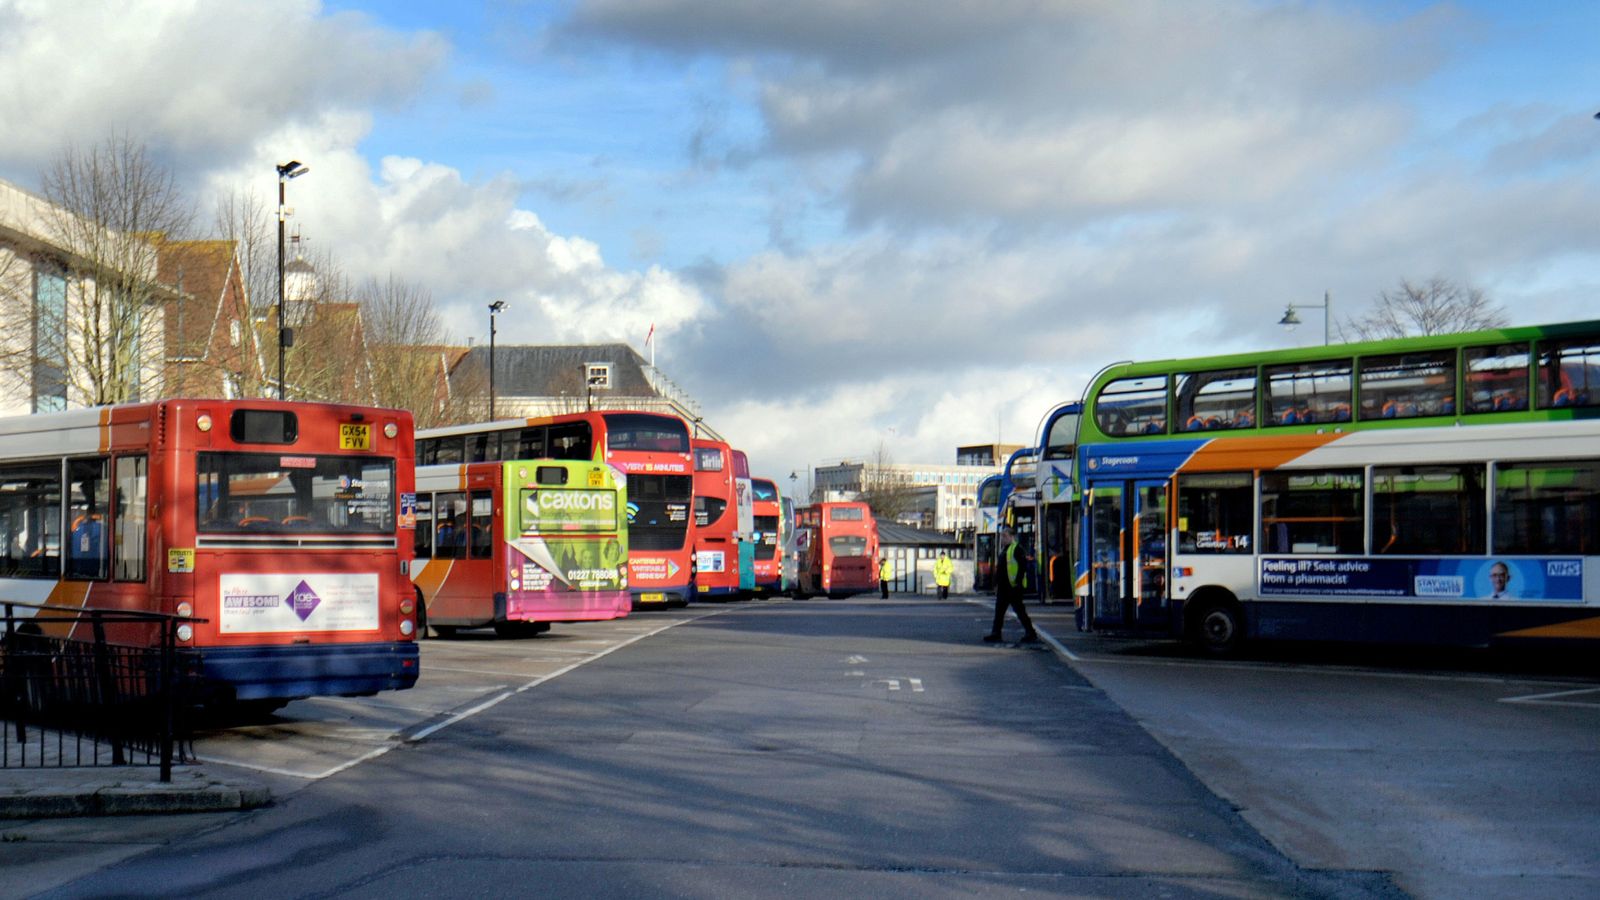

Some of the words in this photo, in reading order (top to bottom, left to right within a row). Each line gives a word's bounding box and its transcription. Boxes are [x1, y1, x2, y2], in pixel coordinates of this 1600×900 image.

[342, 425, 367, 437] GX54
[345, 438, 364, 448] FVV
[645, 463, 653, 472] 15
[653, 463, 684, 472] MINUTES
[1102, 456, 1138, 467] Stagecoach
[541, 491, 613, 511] caxtons
[1233, 534, 1249, 549] 14
[1263, 560, 1297, 574] Feeling
[1297, 560, 1311, 572] ill?
[1313, 560, 1337, 572] Seek
[1338, 561, 1370, 572] advice
[1549, 561, 1580, 576] NHS
[567, 570, 590, 581] 01227
[1262, 573, 1286, 584] from
[1287, 575, 1294, 584] a
[1295, 573, 1348, 586] pharmacist
[224, 596, 279, 608] AWESOME
